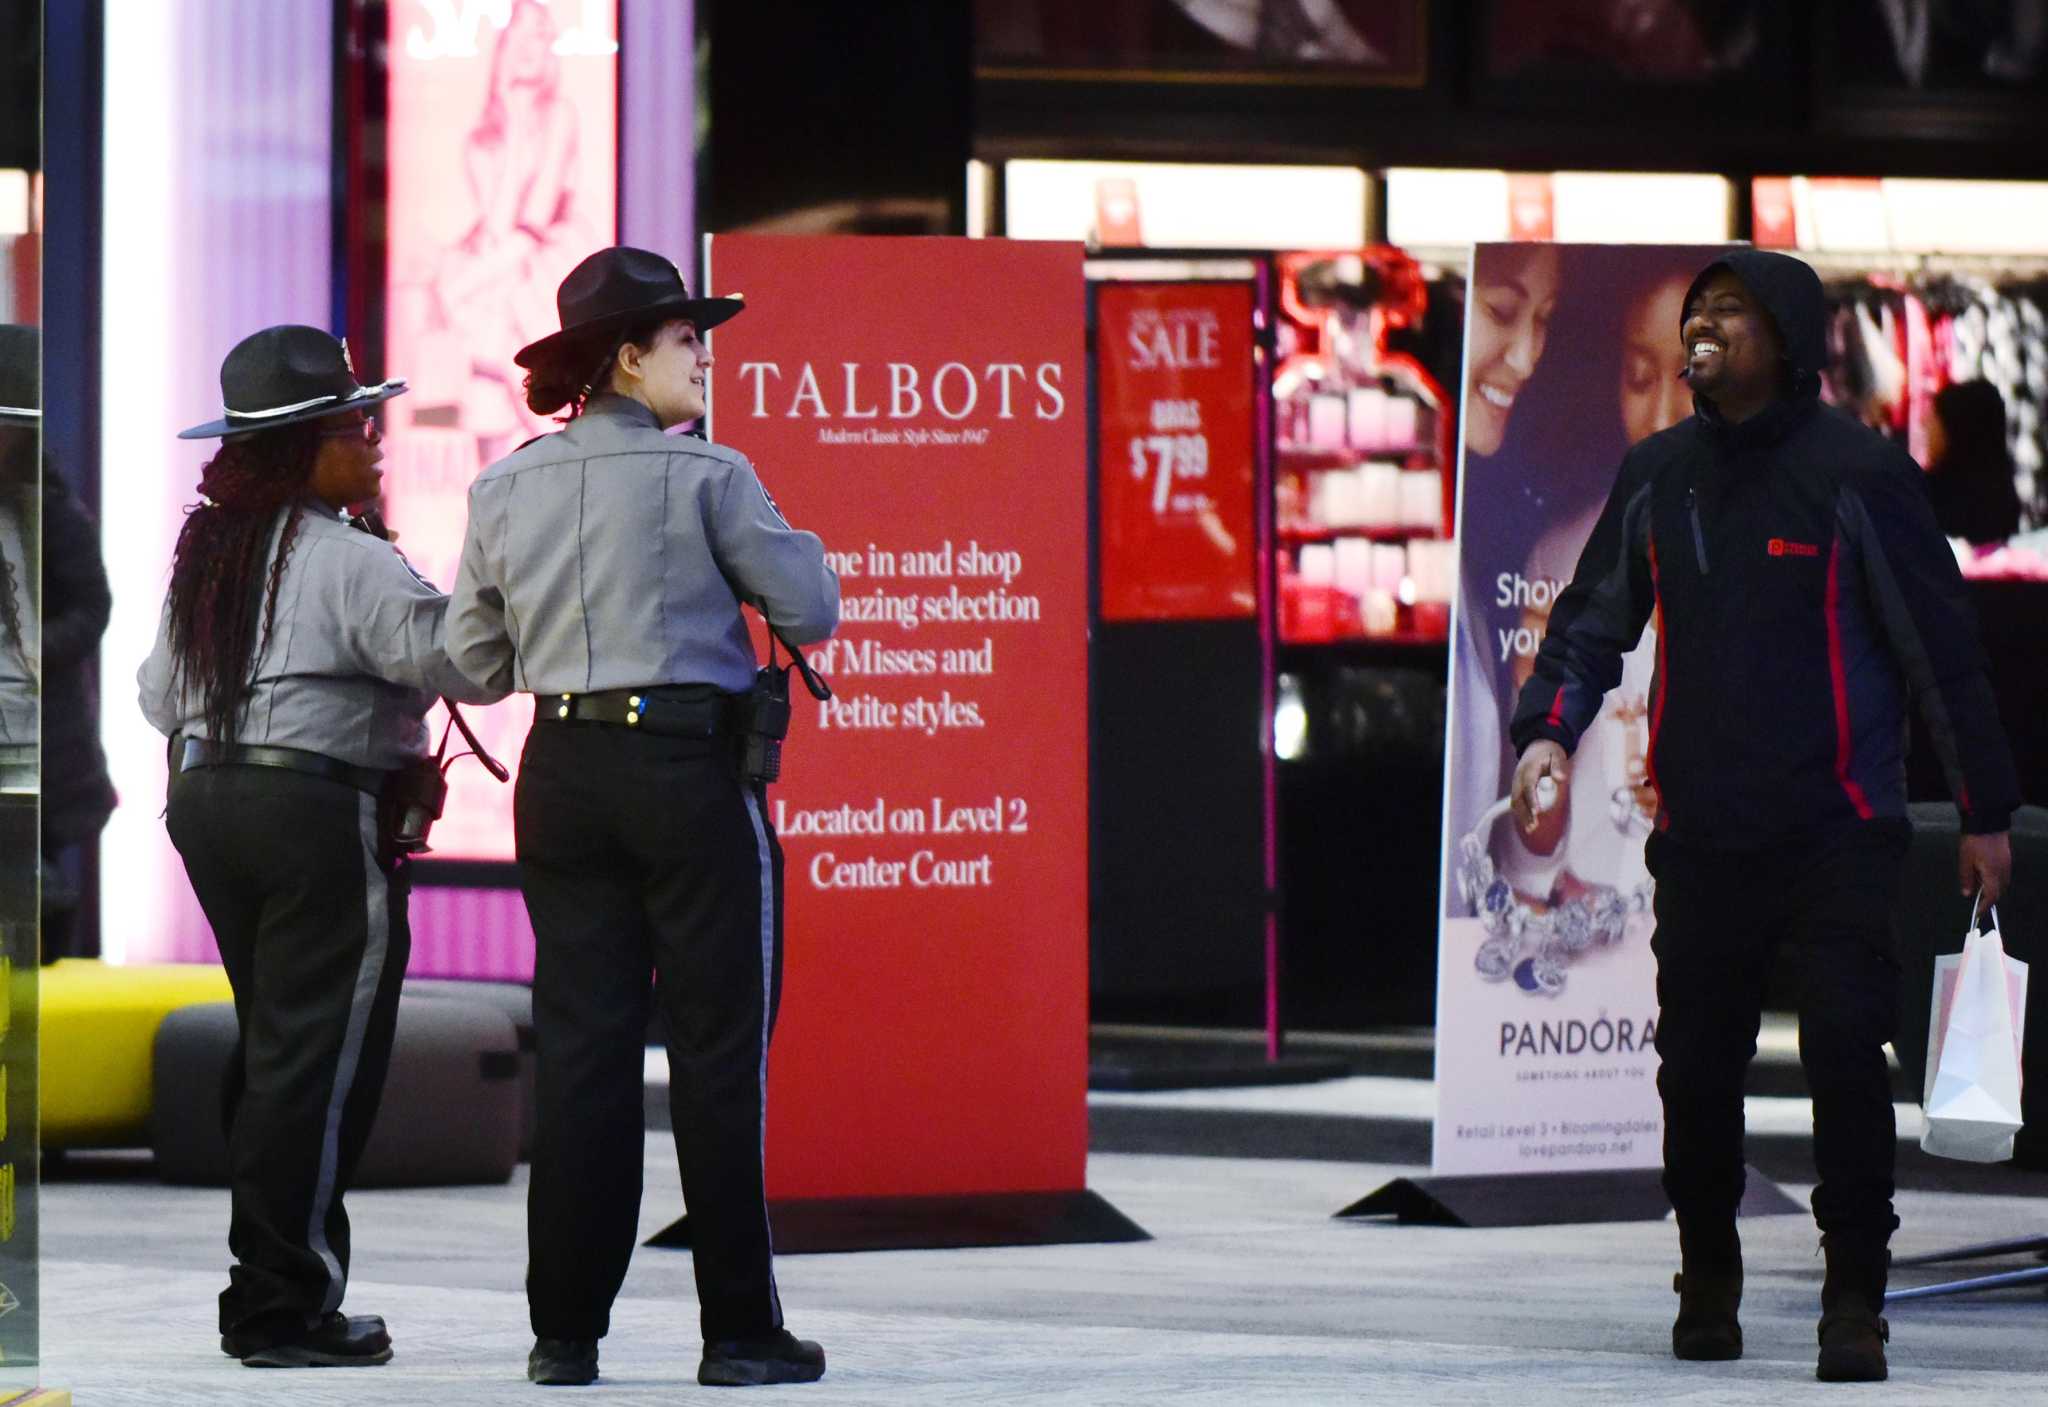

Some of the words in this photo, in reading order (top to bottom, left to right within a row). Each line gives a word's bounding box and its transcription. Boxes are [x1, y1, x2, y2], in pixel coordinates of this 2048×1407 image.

[1129, 309, 1220, 369] SALE
[739, 361, 1066, 420] TALBOTS
[818, 427, 862, 444] Modern
[863, 427, 899, 444] Classic
[903, 427, 930, 448] Style
[931, 428, 960, 444] Since
[823, 551, 863, 577] me
[868, 542, 896, 577] in
[901, 540, 952, 577] and
[957, 540, 1022, 584] shop
[839, 587, 919, 629] azing
[922, 584, 1040, 622] selection
[807, 639, 839, 674] of
[843, 639, 936, 674] Misses
[942, 638, 993, 674] and
[818, 694, 897, 729] Petite
[902, 692, 985, 736] styles.
[775, 798, 884, 836] Located
[890, 808, 924, 834] on
[932, 797, 1002, 834] Level
[1009, 798, 1029, 833] 2
[810, 853, 905, 889] Center
[910, 850, 993, 887] Court
[1499, 1018, 1657, 1056] PANDORA
[1456, 1125, 1496, 1139] Retail
[1500, 1123, 1536, 1138] Level
[1540, 1124, 1548, 1137] 3
